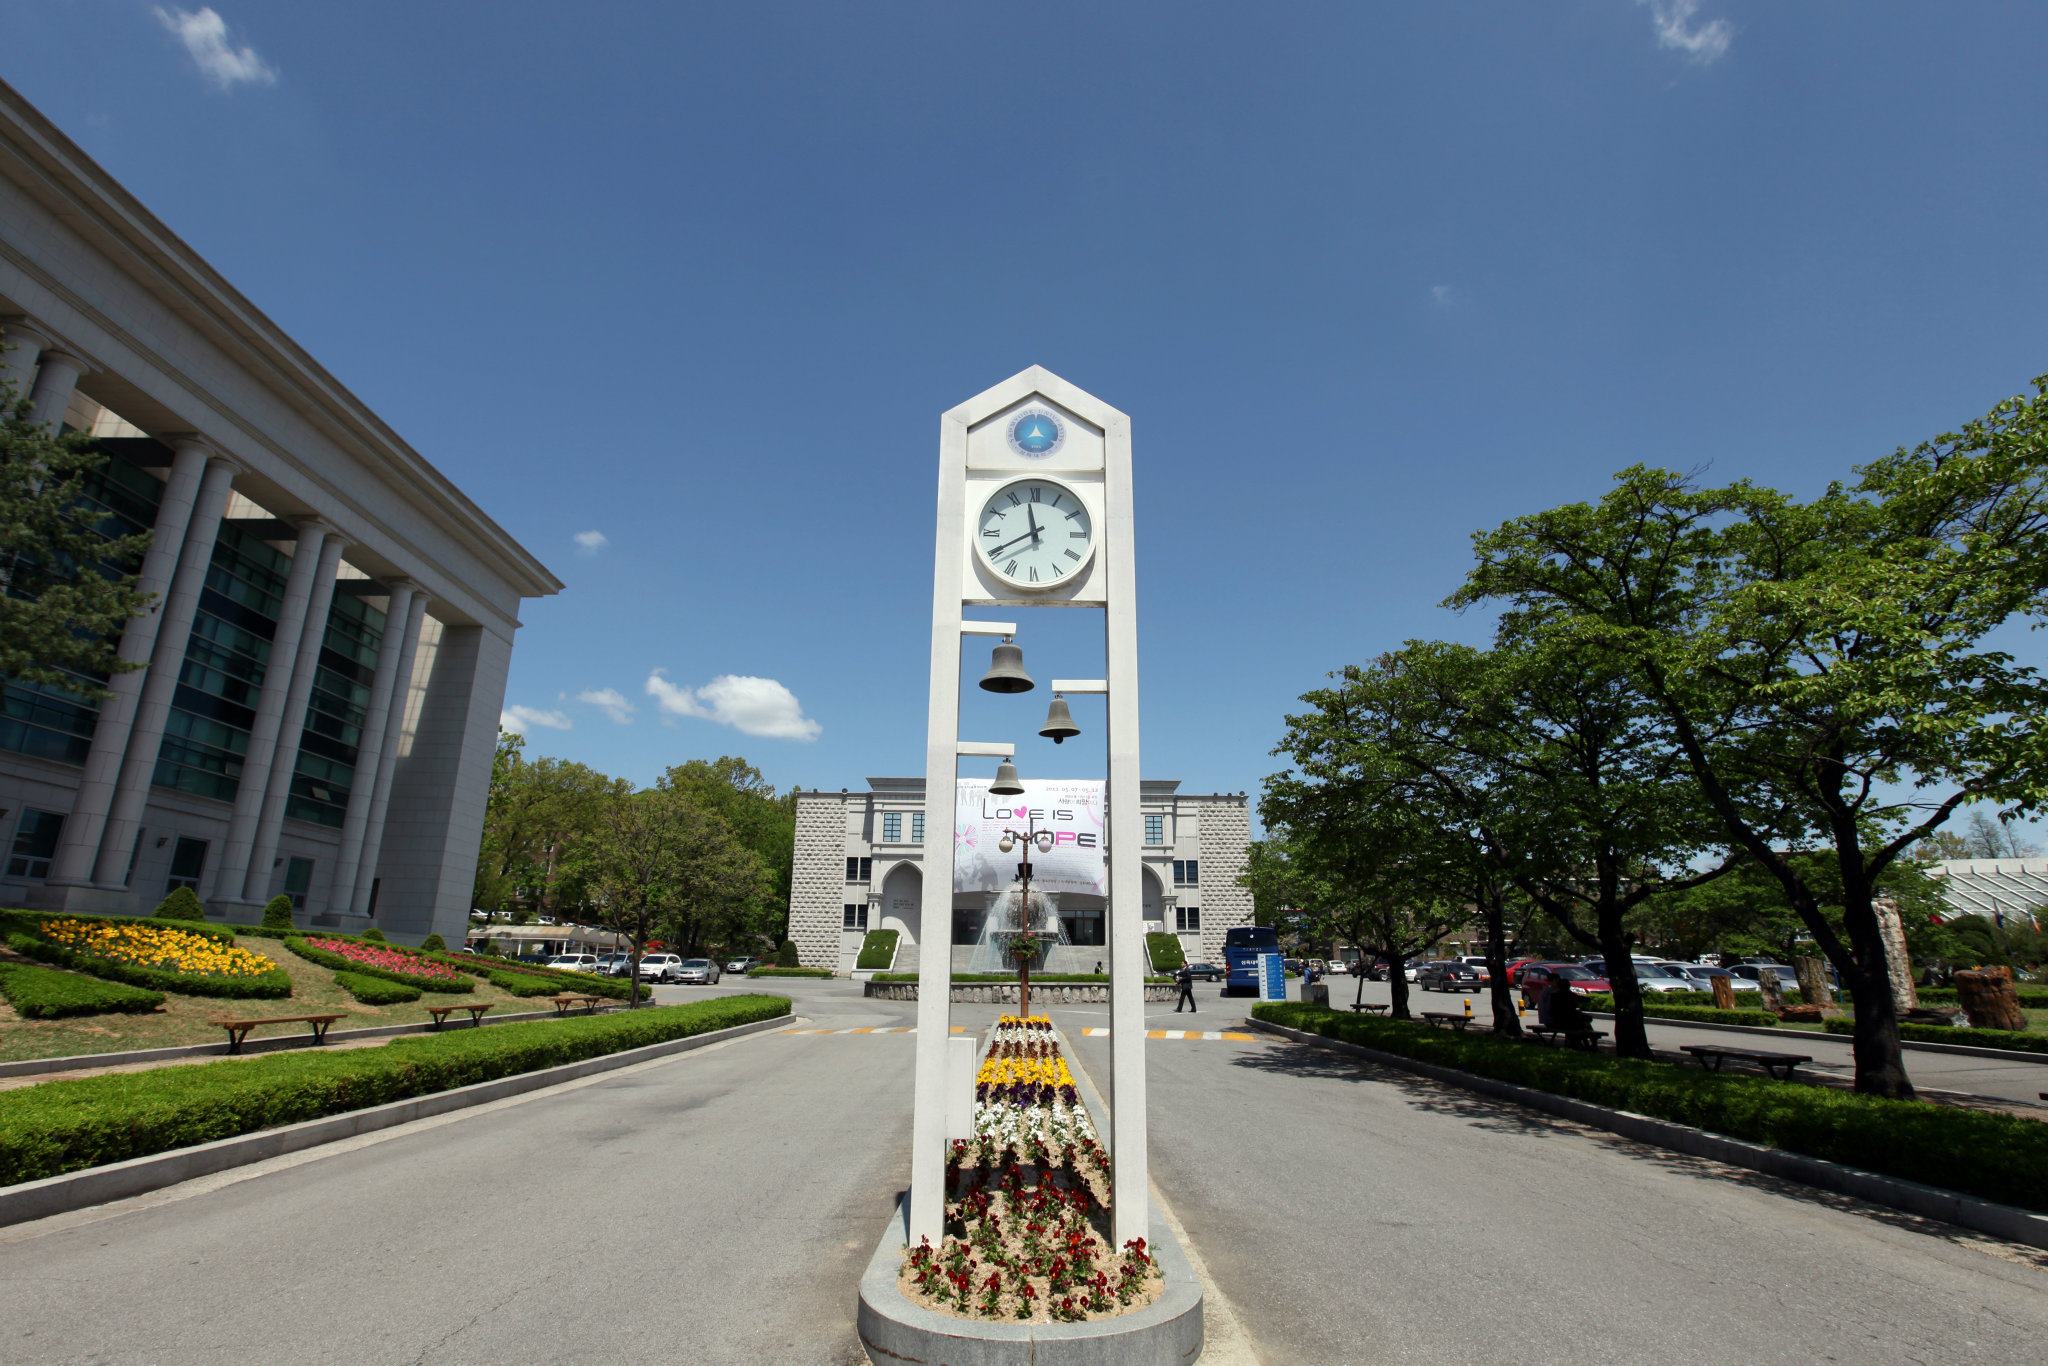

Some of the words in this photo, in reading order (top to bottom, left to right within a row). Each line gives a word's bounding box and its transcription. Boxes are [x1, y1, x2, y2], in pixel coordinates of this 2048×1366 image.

[1007, 491, 1022, 508] XI
[1029, 487, 1041, 503] XII
[989, 507, 1007, 520] X
[983, 528, 1000, 537] IX
[1052, 809, 1074, 820] IS
